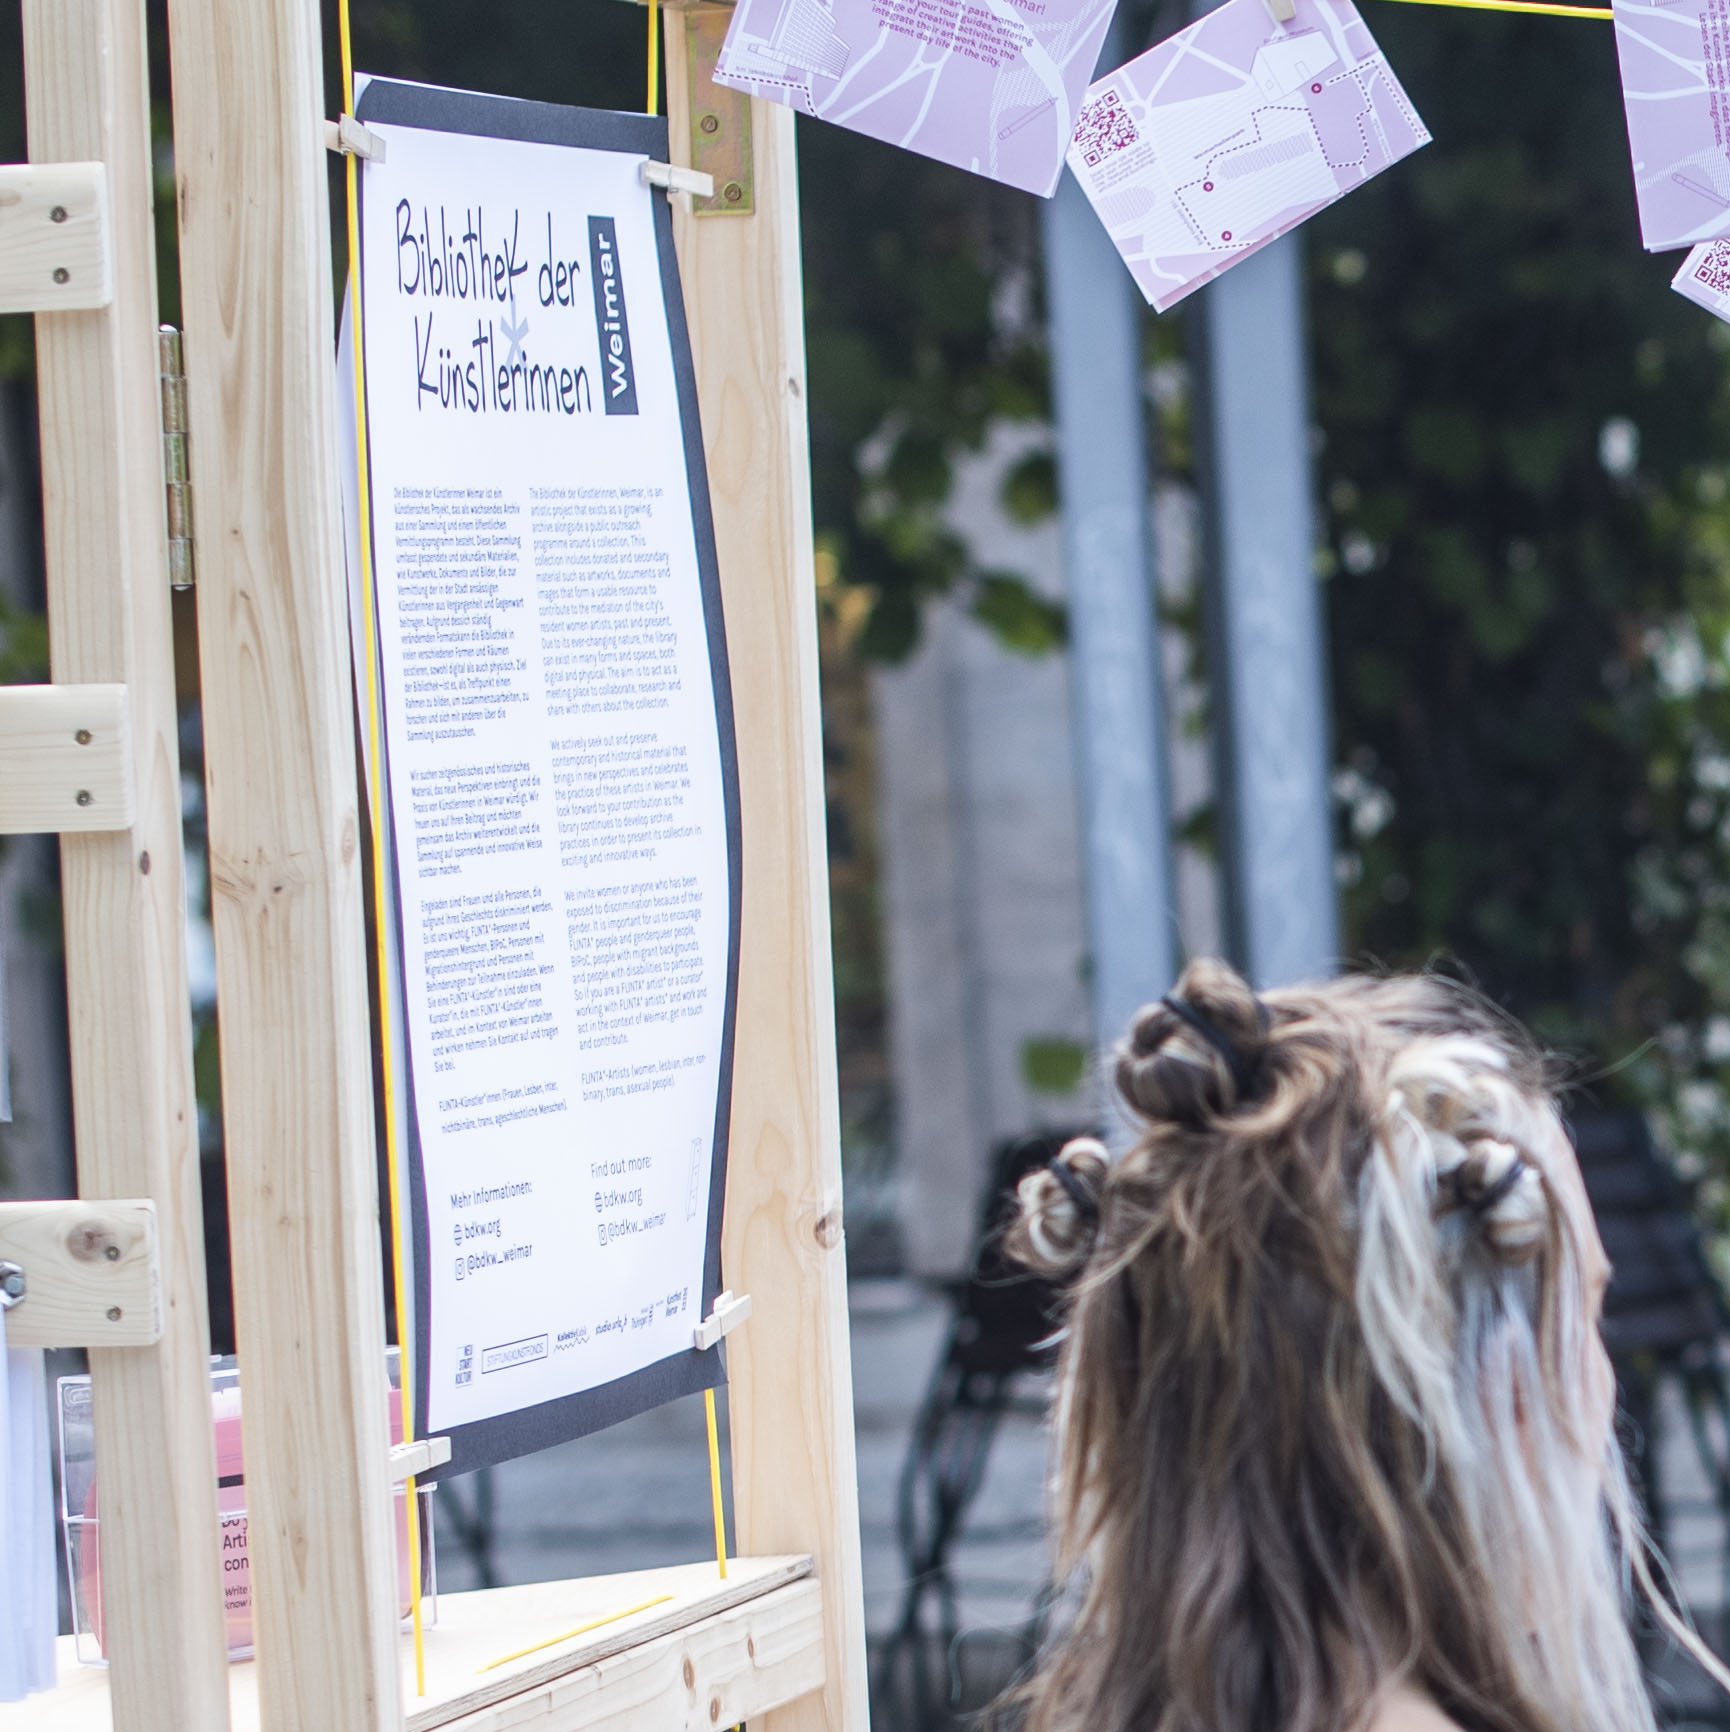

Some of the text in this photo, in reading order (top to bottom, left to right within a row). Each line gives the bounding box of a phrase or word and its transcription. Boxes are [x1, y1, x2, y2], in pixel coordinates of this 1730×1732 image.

[872, 4, 1015, 61] integrate their artwork into the
[878, 19, 914, 37] present
[916, 31, 934, 45] day
[935, 37, 950, 49] life
[953, 45, 963, 53] of
[964, 47, 980, 59] the
[907, 6, 917, 15] of
[918, 11, 956, 29] creative
[958, 25, 1001, 45] activities
[1003, 39, 1023, 52] that
[916, 0, 938, 11] your
[939, 6, 959, 19] tour
[996, 28, 1034, 47] offering
[967, 7, 1024, 31] past women
[396, 199, 580, 307] Bibliothek der
[598, 232, 627, 399] Weimar
[414, 311, 592, 415] Künstlerinnen
[590, 1161, 608, 1178] Find
[610, 1160, 626, 1175] out
[450, 1181, 533, 1210] Mehr Informationen:
